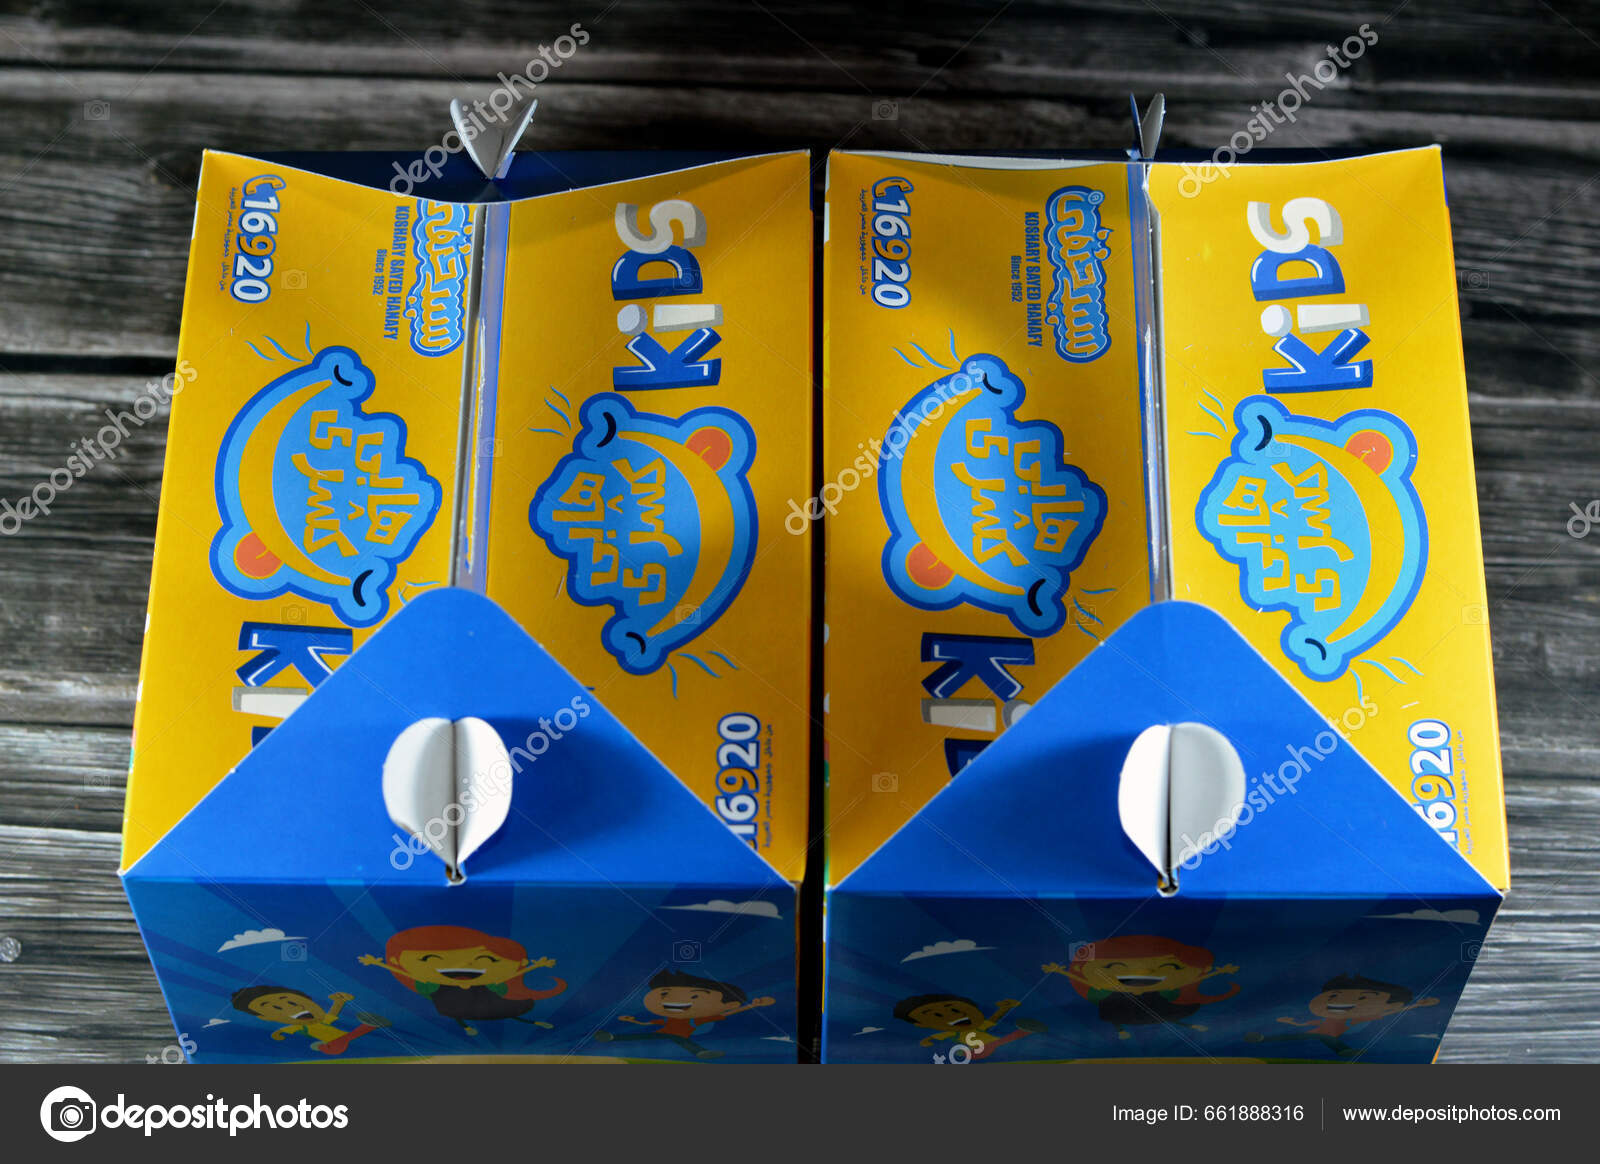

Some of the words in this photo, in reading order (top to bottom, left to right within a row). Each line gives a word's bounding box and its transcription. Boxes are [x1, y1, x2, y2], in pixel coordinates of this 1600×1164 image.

[231, 195, 280, 303] 16920
[391, 206, 410, 258] KOSHARY
[871, 199, 912, 309] 16920
[1024, 211, 1040, 264] KOSHARY
[373, 249, 387, 273] Since
[388, 259, 406, 293] SAYED
[1025, 265, 1041, 301] SAYED
[371, 275, 385, 296] 1952
[1011, 282, 1023, 302] 1952
[383, 296, 401, 341] HANAFY
[1026, 303, 1042, 348] HANAFY
